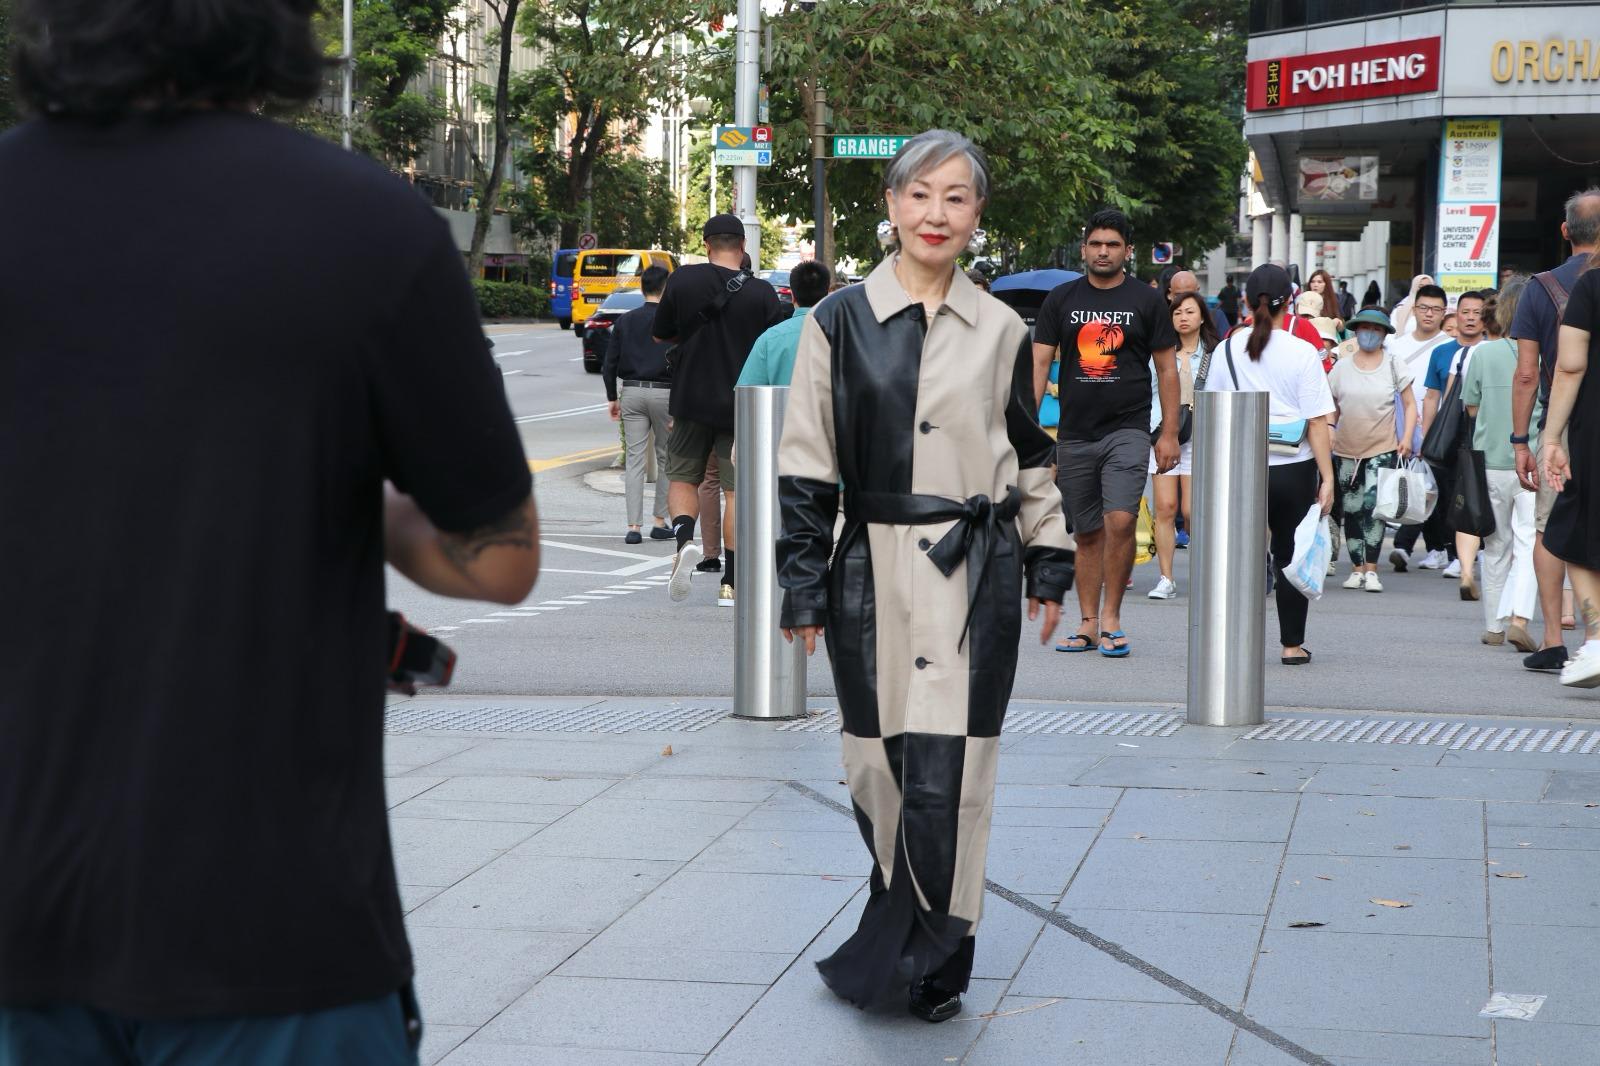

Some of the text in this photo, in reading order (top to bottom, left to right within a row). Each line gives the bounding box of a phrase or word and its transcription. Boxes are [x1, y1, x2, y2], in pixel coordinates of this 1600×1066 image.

[1267, 62, 1279, 105] 宝兴
[1291, 53, 1426, 94] POH HENG
[837, 138, 897, 155] GRANGE
[1449, 130, 1497, 138] Australia
[1446, 207, 1467, 215] Level
[1469, 205, 1497, 260] 7
[1070, 310, 1134, 325] SUNSET
